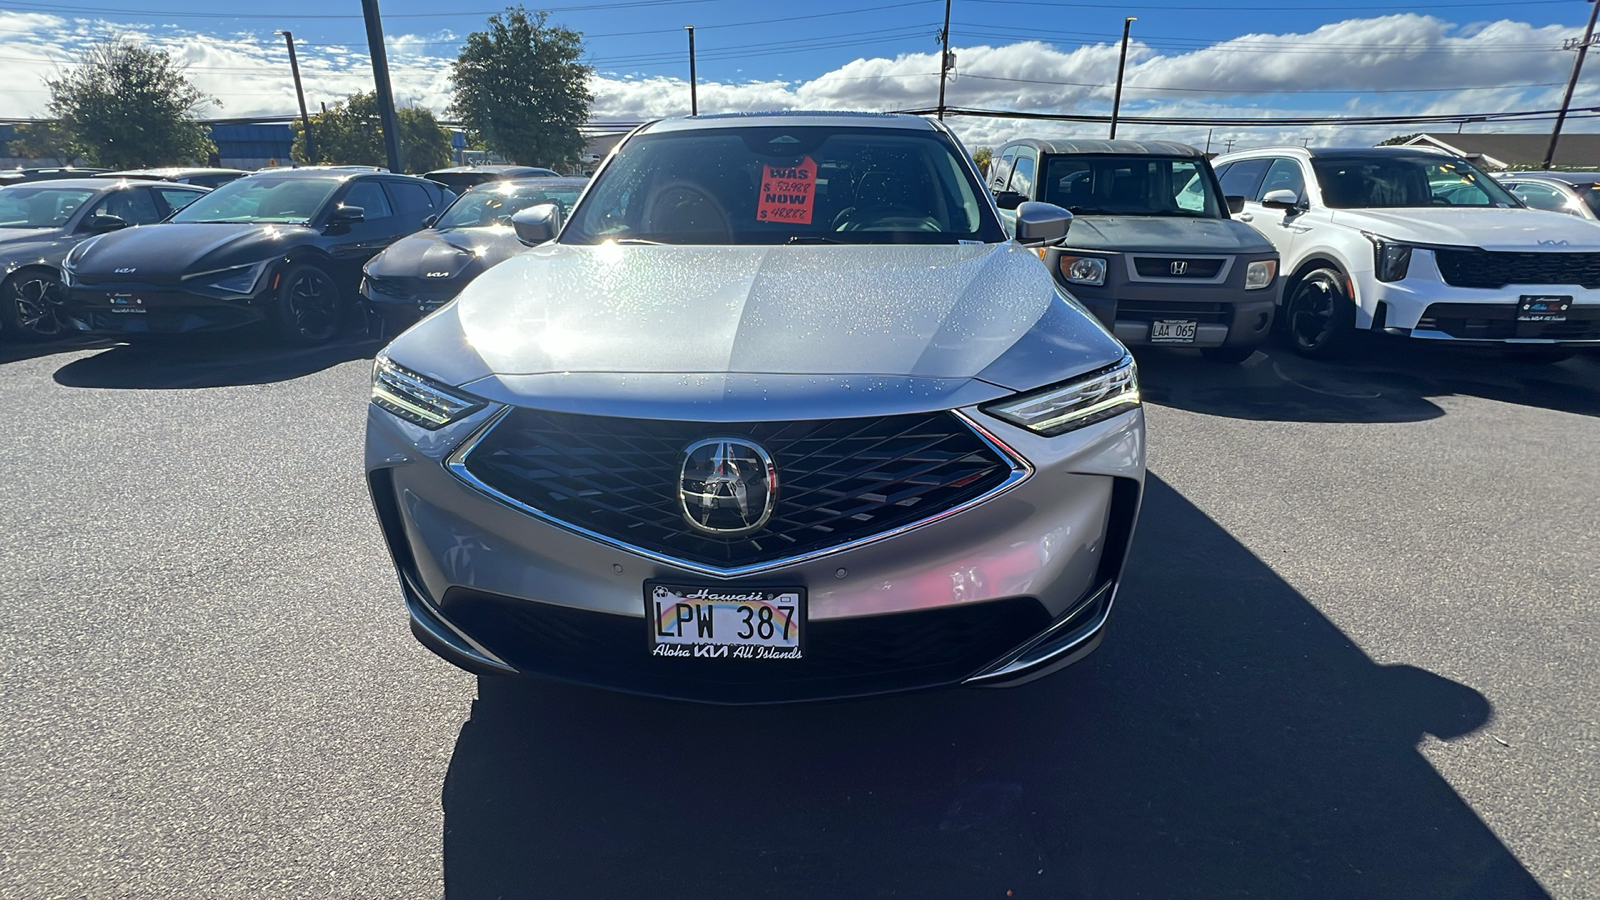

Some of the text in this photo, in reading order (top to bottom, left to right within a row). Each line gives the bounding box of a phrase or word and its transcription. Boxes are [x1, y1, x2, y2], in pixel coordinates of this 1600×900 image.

[769, 169, 808, 180] WAS
[765, 193, 807, 204] NOW
[1152, 324, 1195, 337] LAA 065
[686, 589, 763, 601] Hawaii
[656, 602, 795, 641] LPW 387
[652, 644, 803, 660] Aloha KIA All Islands
